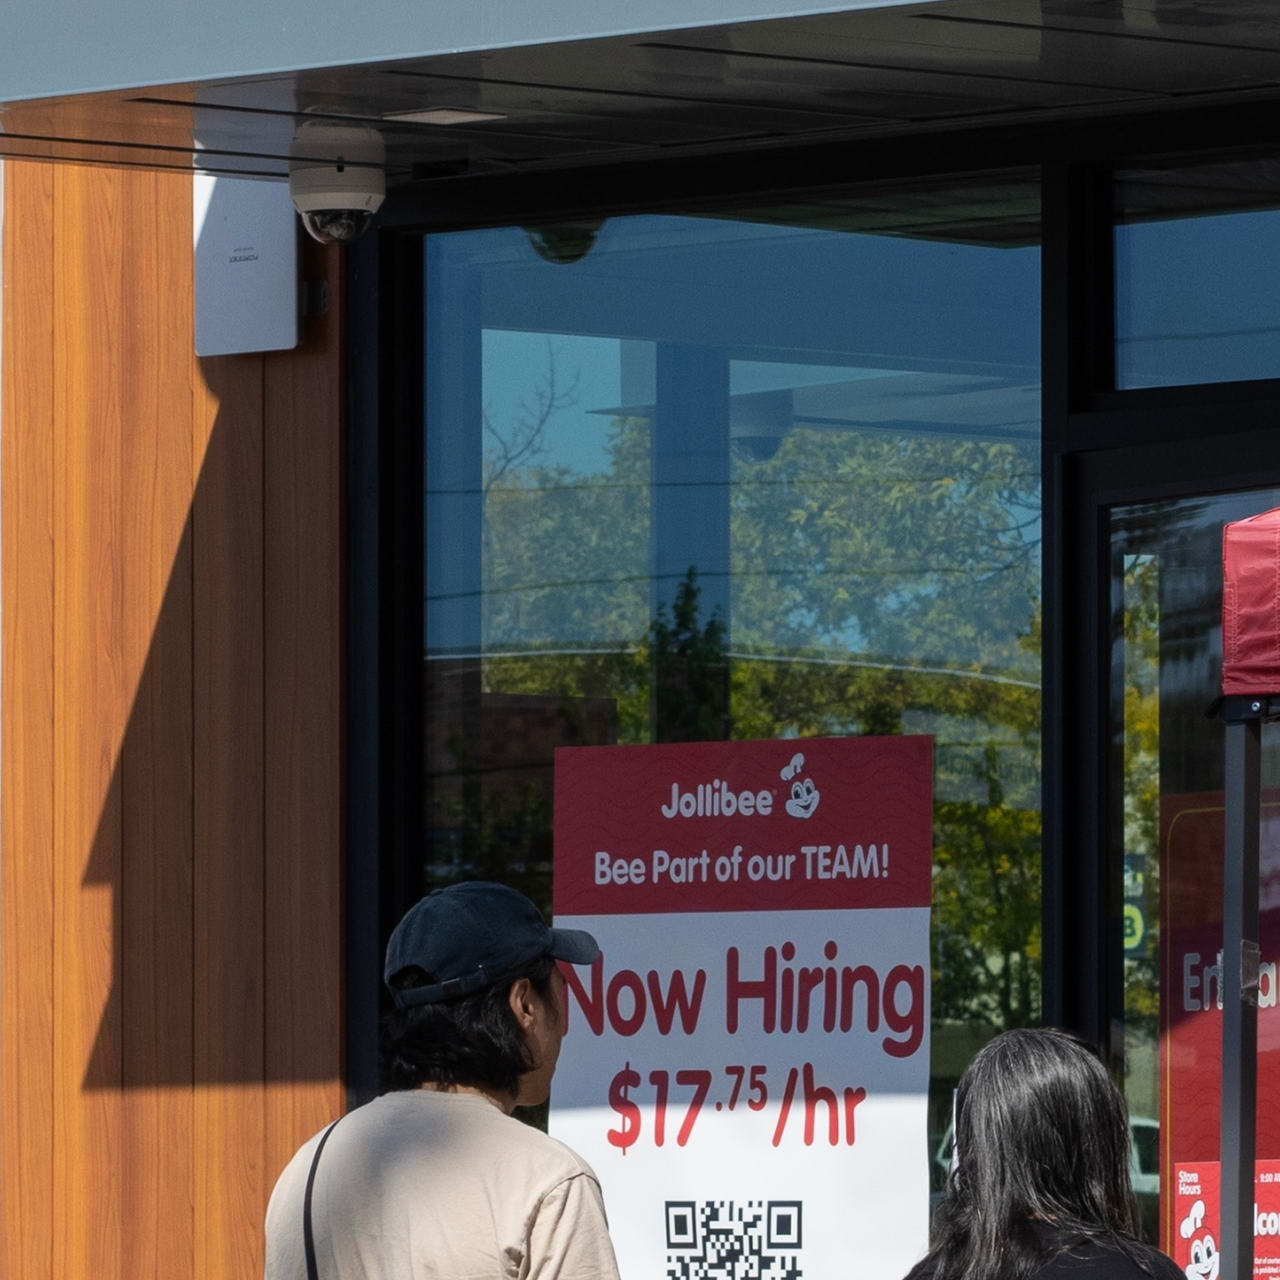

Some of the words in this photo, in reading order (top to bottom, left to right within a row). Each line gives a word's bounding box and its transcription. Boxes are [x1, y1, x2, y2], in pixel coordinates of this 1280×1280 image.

[660, 778, 773, 819] Jollibee
[594, 851, 646, 886] Bee
[652, 849, 711, 885] Part
[714, 845, 743, 883] of
[746, 854, 797, 882] our
[800, 843, 889, 880] TEAM!
[556, 950, 707, 1037] Now
[726, 939, 925, 1058] Hiring
[1178, 1170, 1199, 1183] Store
[1178, 1183, 1202, 1196] Hours
[1259, 1173, 1273, 1183] 9:00
